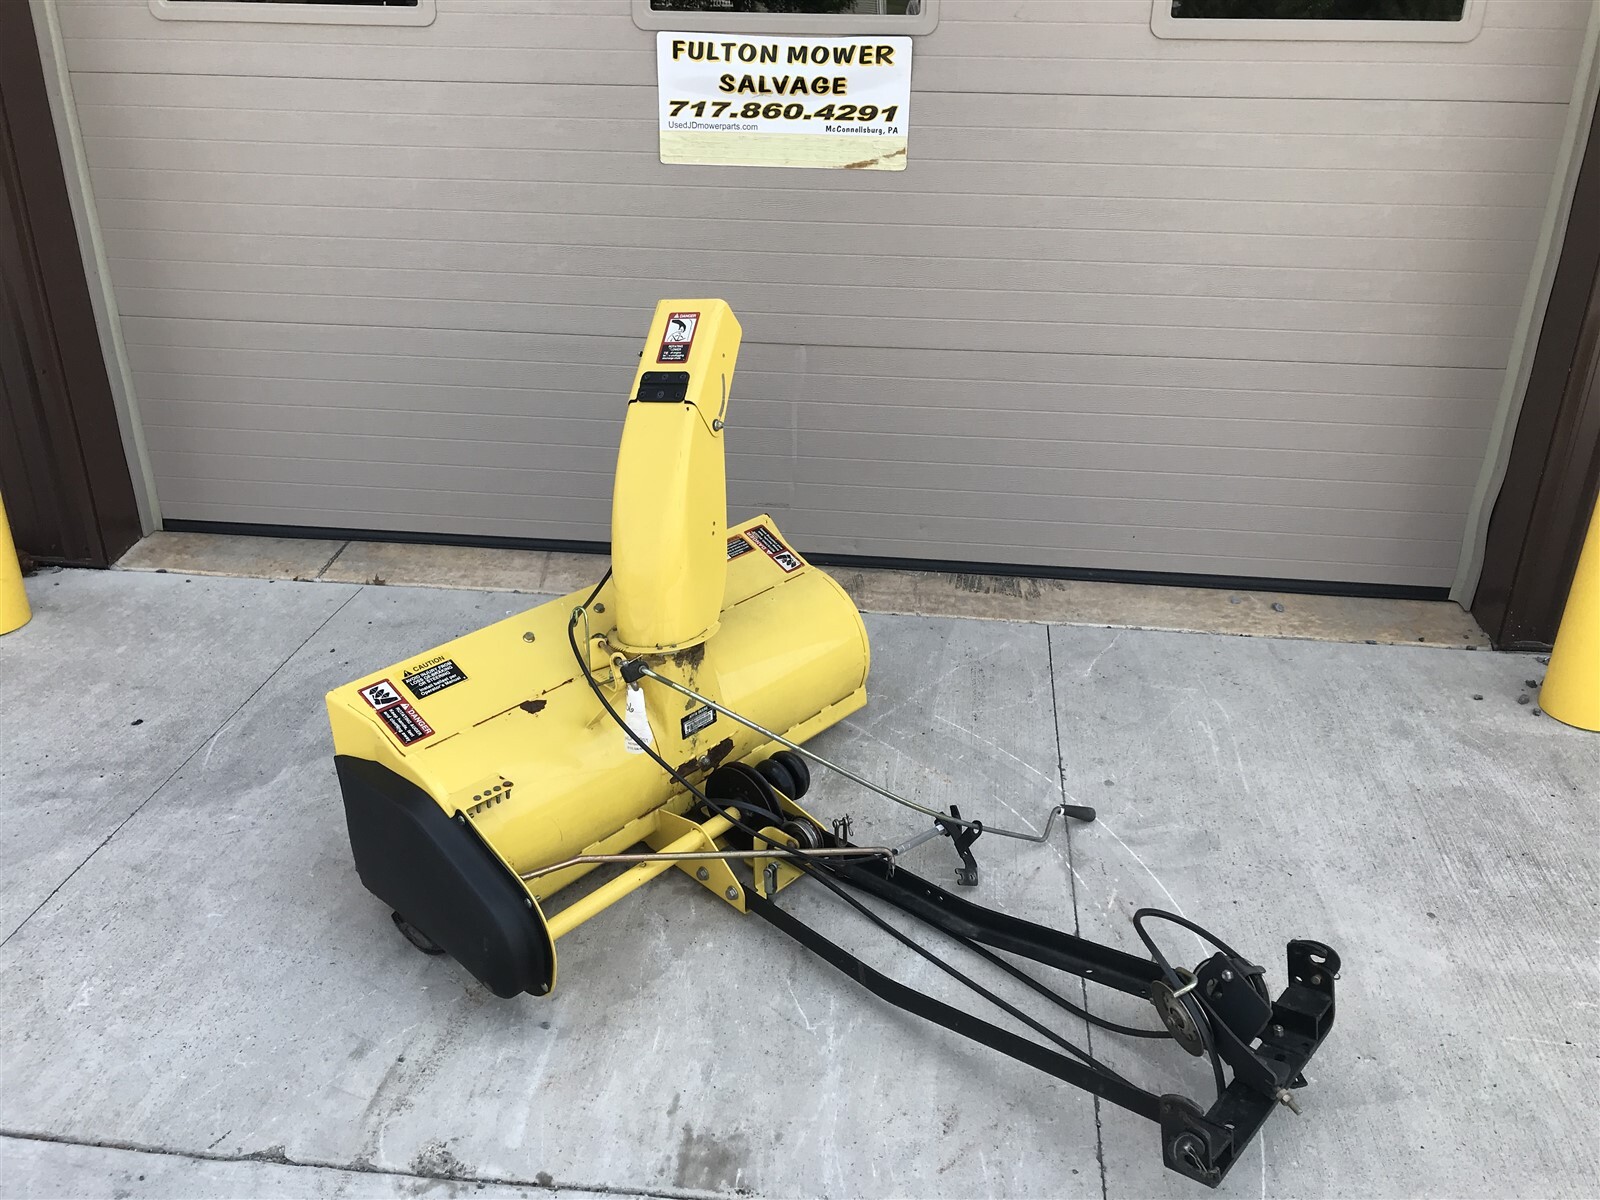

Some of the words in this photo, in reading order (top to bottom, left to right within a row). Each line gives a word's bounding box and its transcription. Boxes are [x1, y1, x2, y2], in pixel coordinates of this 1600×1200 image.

[672, 40, 779, 65] FULTON
[787, 44, 896, 66] MOWER
[718, 73, 847, 96] SALVAGE
[668, 100, 899, 122] 717.860.4291
[668, 121, 758, 131] UsedJDmowerparts.com
[825, 125, 886, 135] McConnellsburg,
[413, 656, 445, 672] CAUTION
[405, 675, 421, 683] AVOID
[420, 667, 437, 677] INJURY
[406, 710, 432, 733] DANGER
